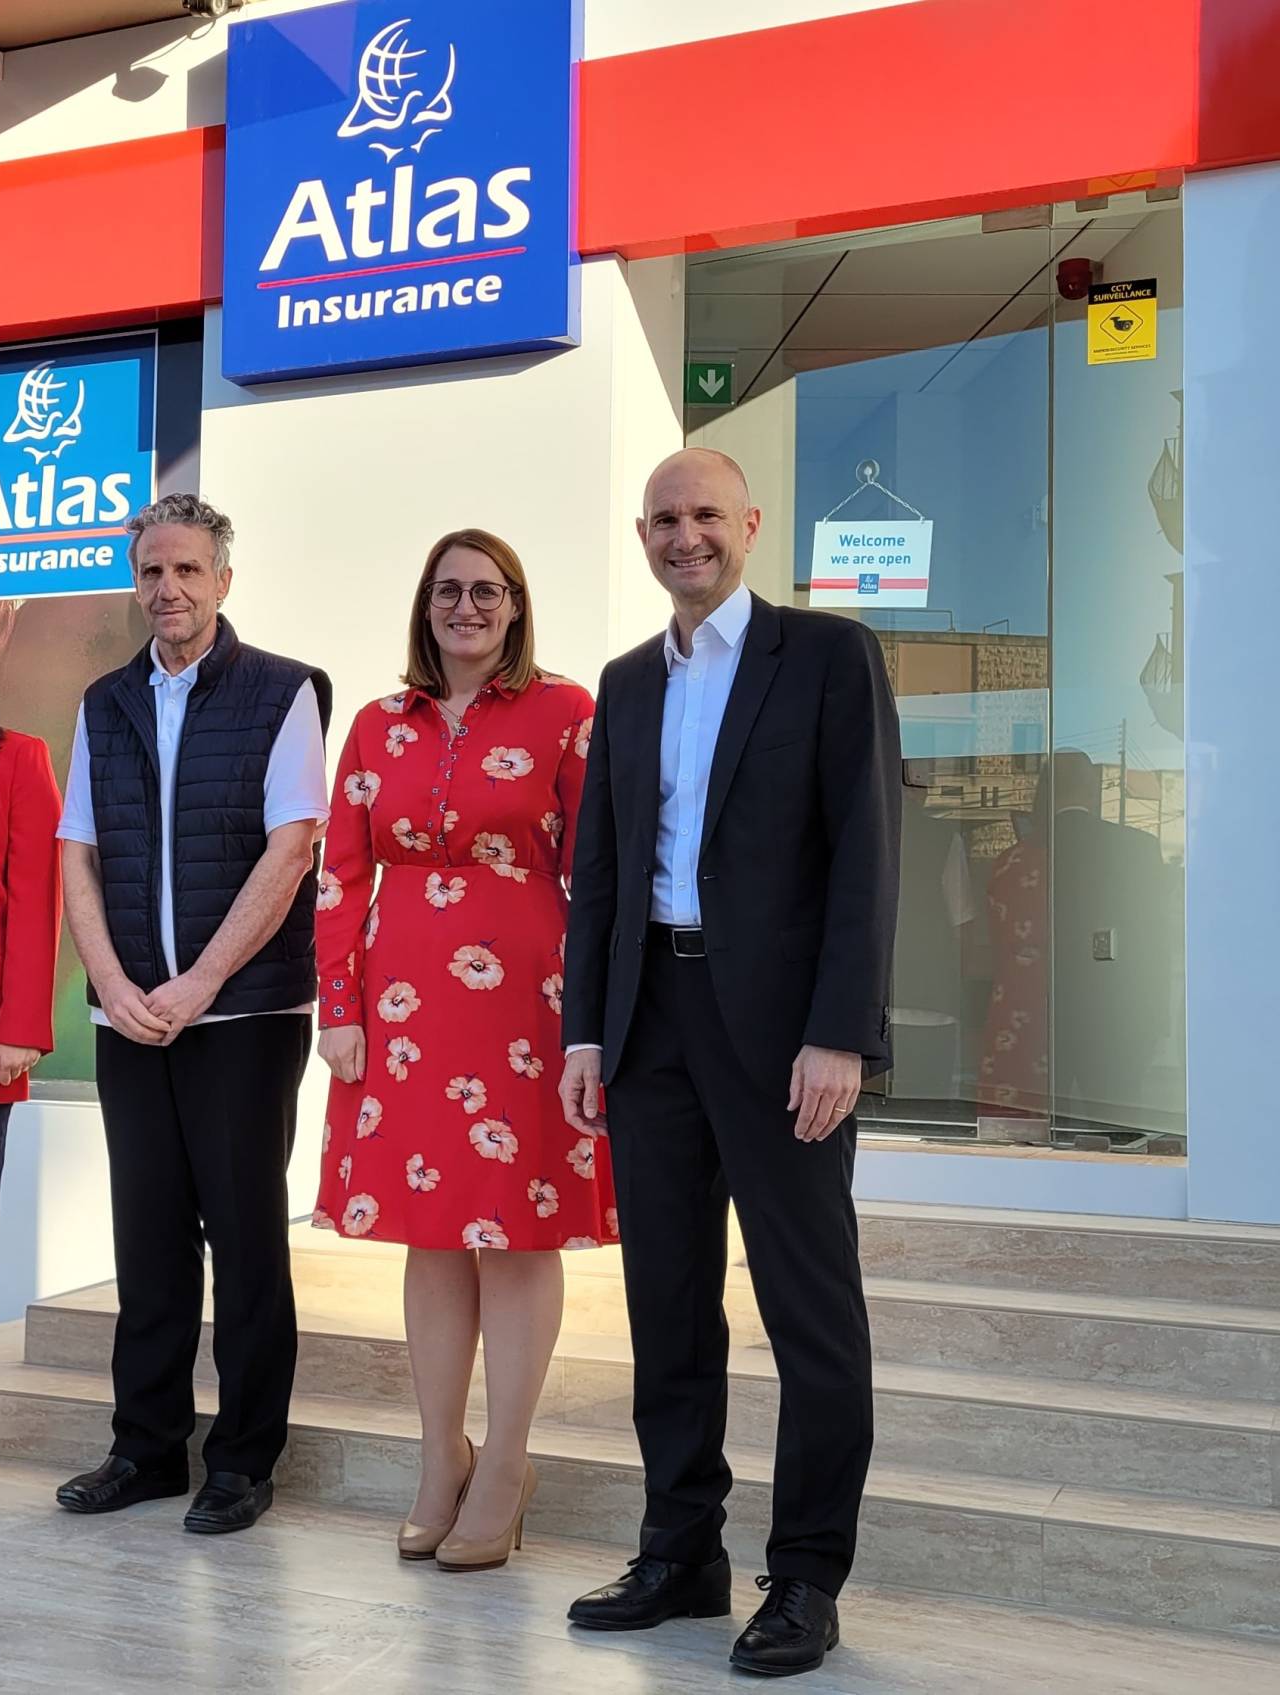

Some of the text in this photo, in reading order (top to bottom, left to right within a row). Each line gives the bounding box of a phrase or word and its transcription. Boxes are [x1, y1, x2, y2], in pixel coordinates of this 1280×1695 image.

[258, 164, 532, 273] Atlas
[1110, 283, 1133, 293] CCTV
[277, 273, 503, 329] Insurance
[1093, 288, 1153, 302] SURVEILLANCE
[839, 534, 906, 547] Welcome
[830, 554, 912, 567] we are open
